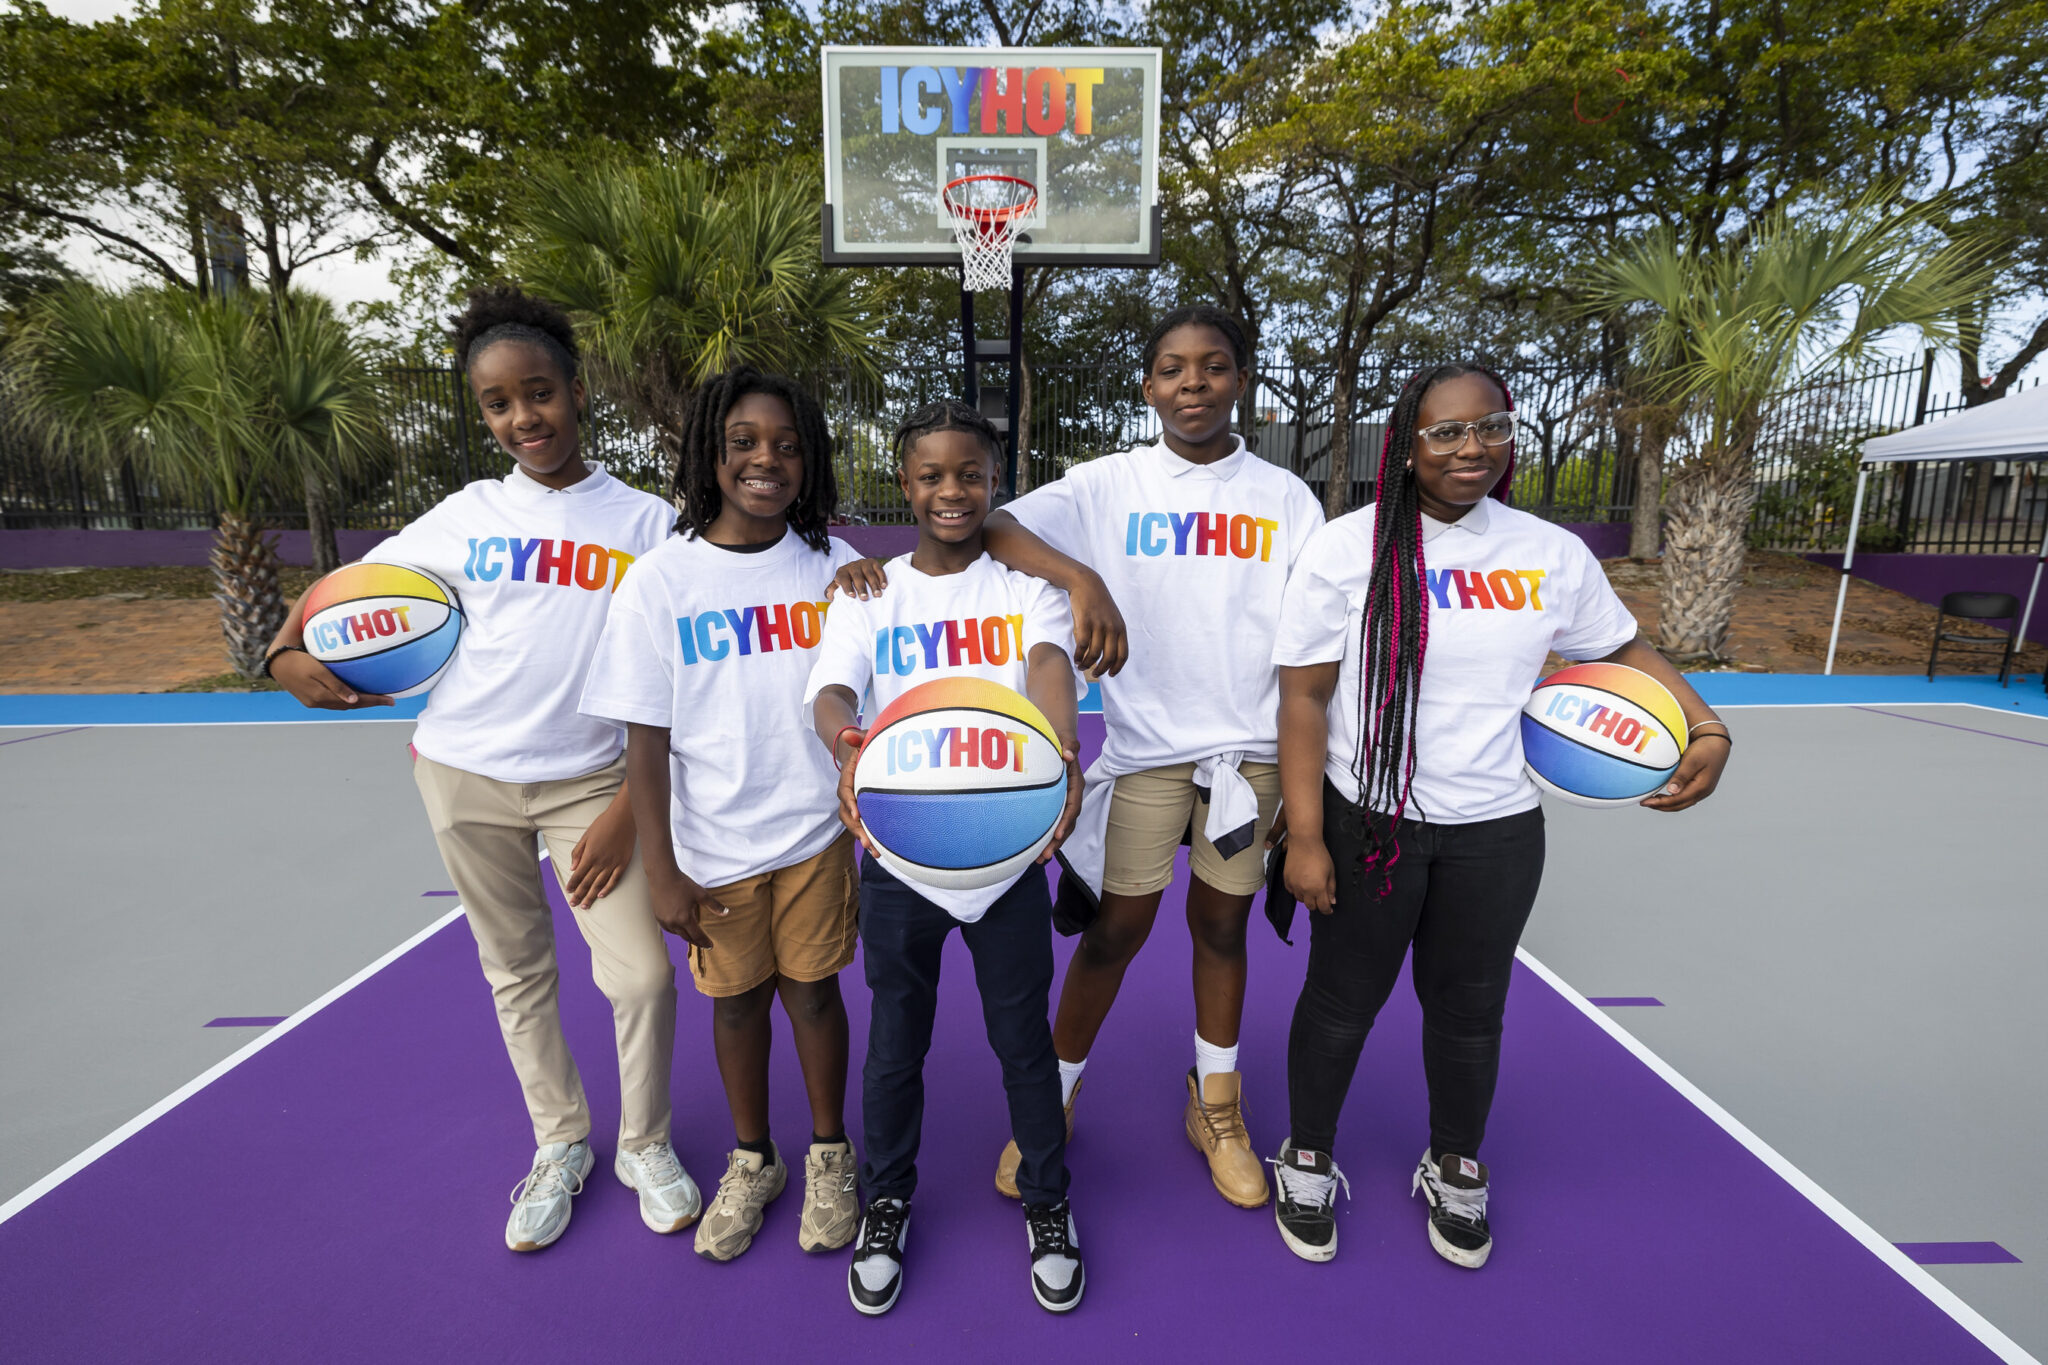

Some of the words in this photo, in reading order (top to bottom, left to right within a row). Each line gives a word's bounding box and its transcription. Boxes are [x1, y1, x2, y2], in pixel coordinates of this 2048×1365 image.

[880, 65, 1105, 136] ICYHOT
[1126, 511, 1279, 563] ICYHOT
[463, 536, 636, 594] ICYHOT
[1416, 568, 1546, 611] YHOT
[311, 605, 411, 654] ICYHOT
[875, 613, 1023, 676] ICYHOT
[1545, 692, 1659, 755] ICYHOT
[887, 727, 1029, 776] ICYHOT
